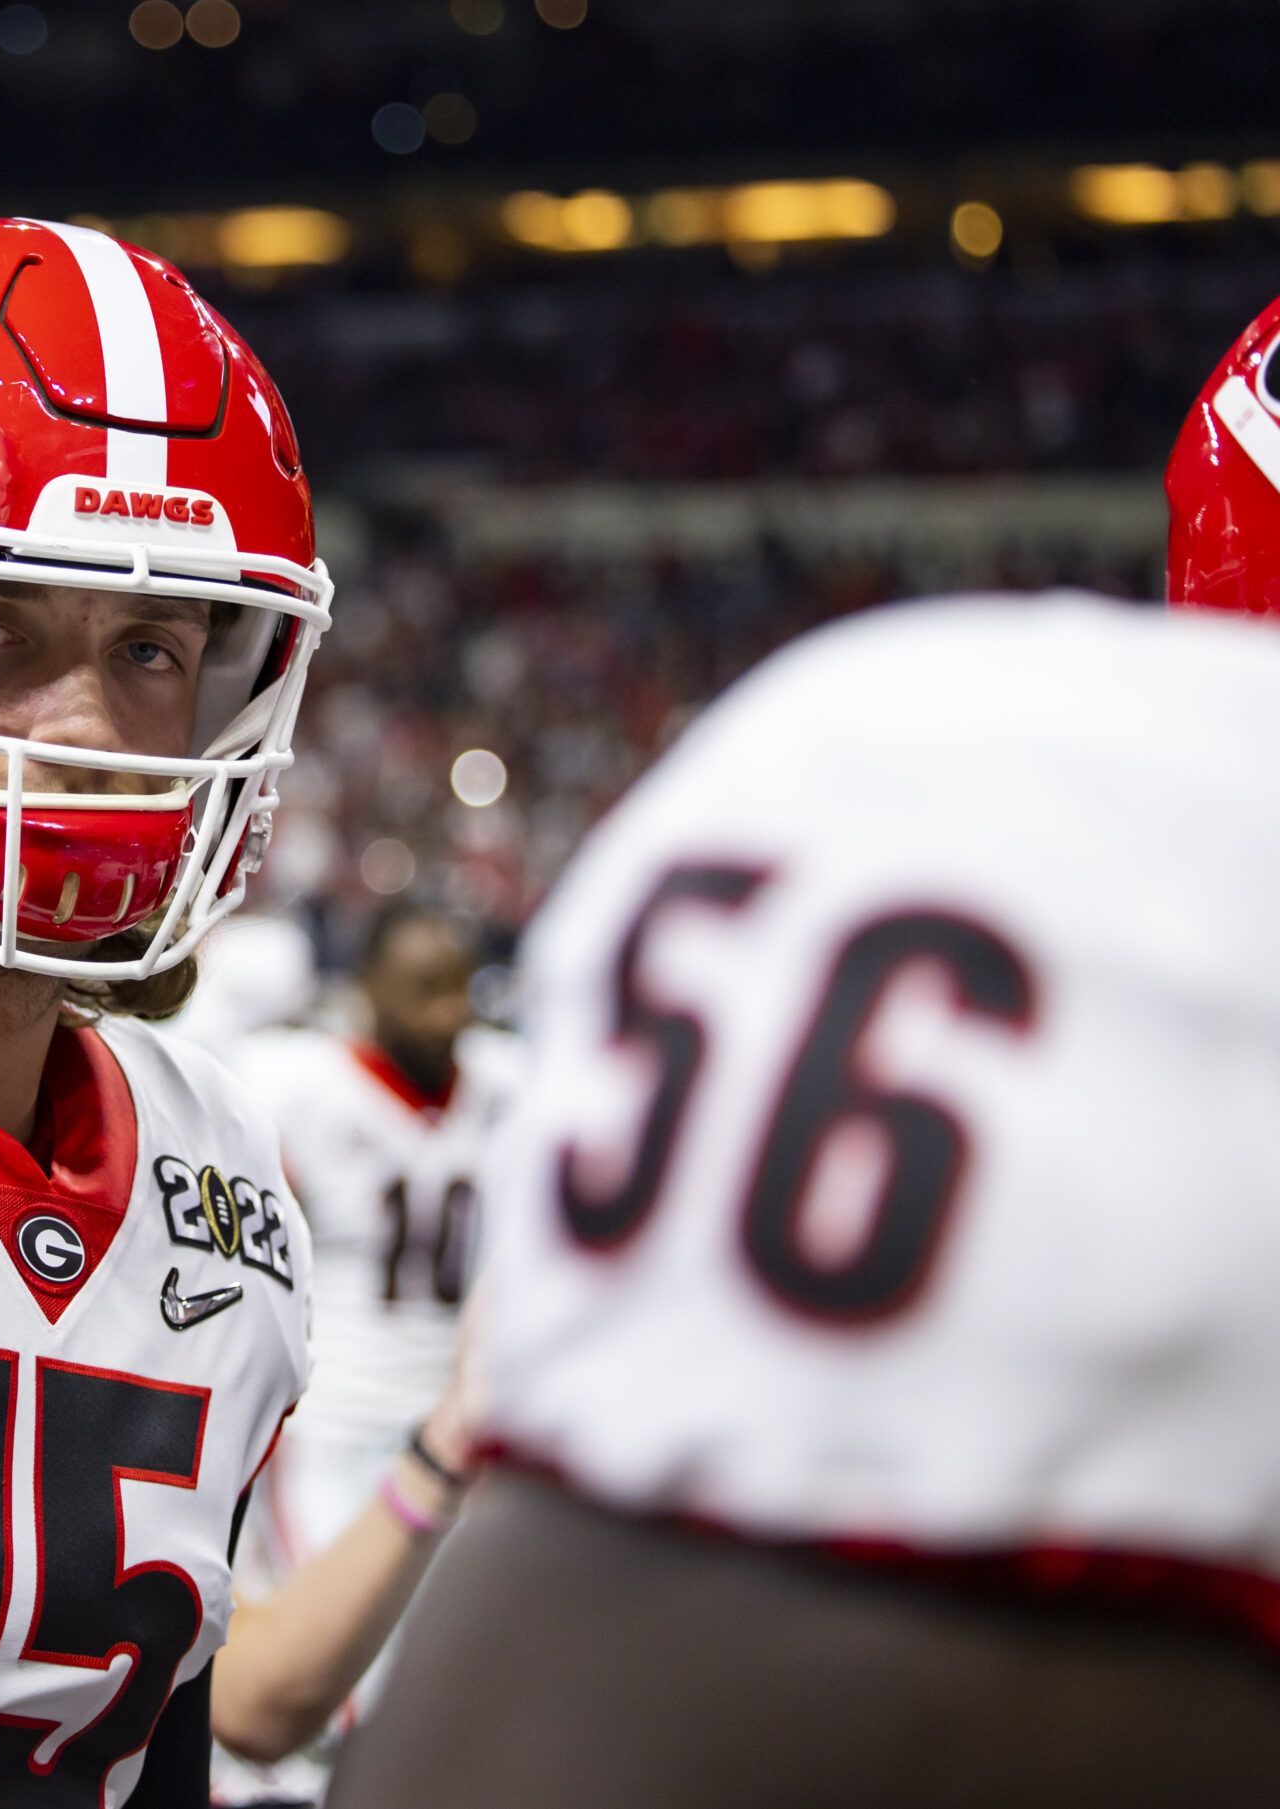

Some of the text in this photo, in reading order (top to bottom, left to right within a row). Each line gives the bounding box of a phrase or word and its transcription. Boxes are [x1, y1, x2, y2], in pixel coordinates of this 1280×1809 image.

[74, 486, 215, 526] DAWGS
[553, 858, 1038, 1328] 56
[18, 1215, 86, 1282] G
